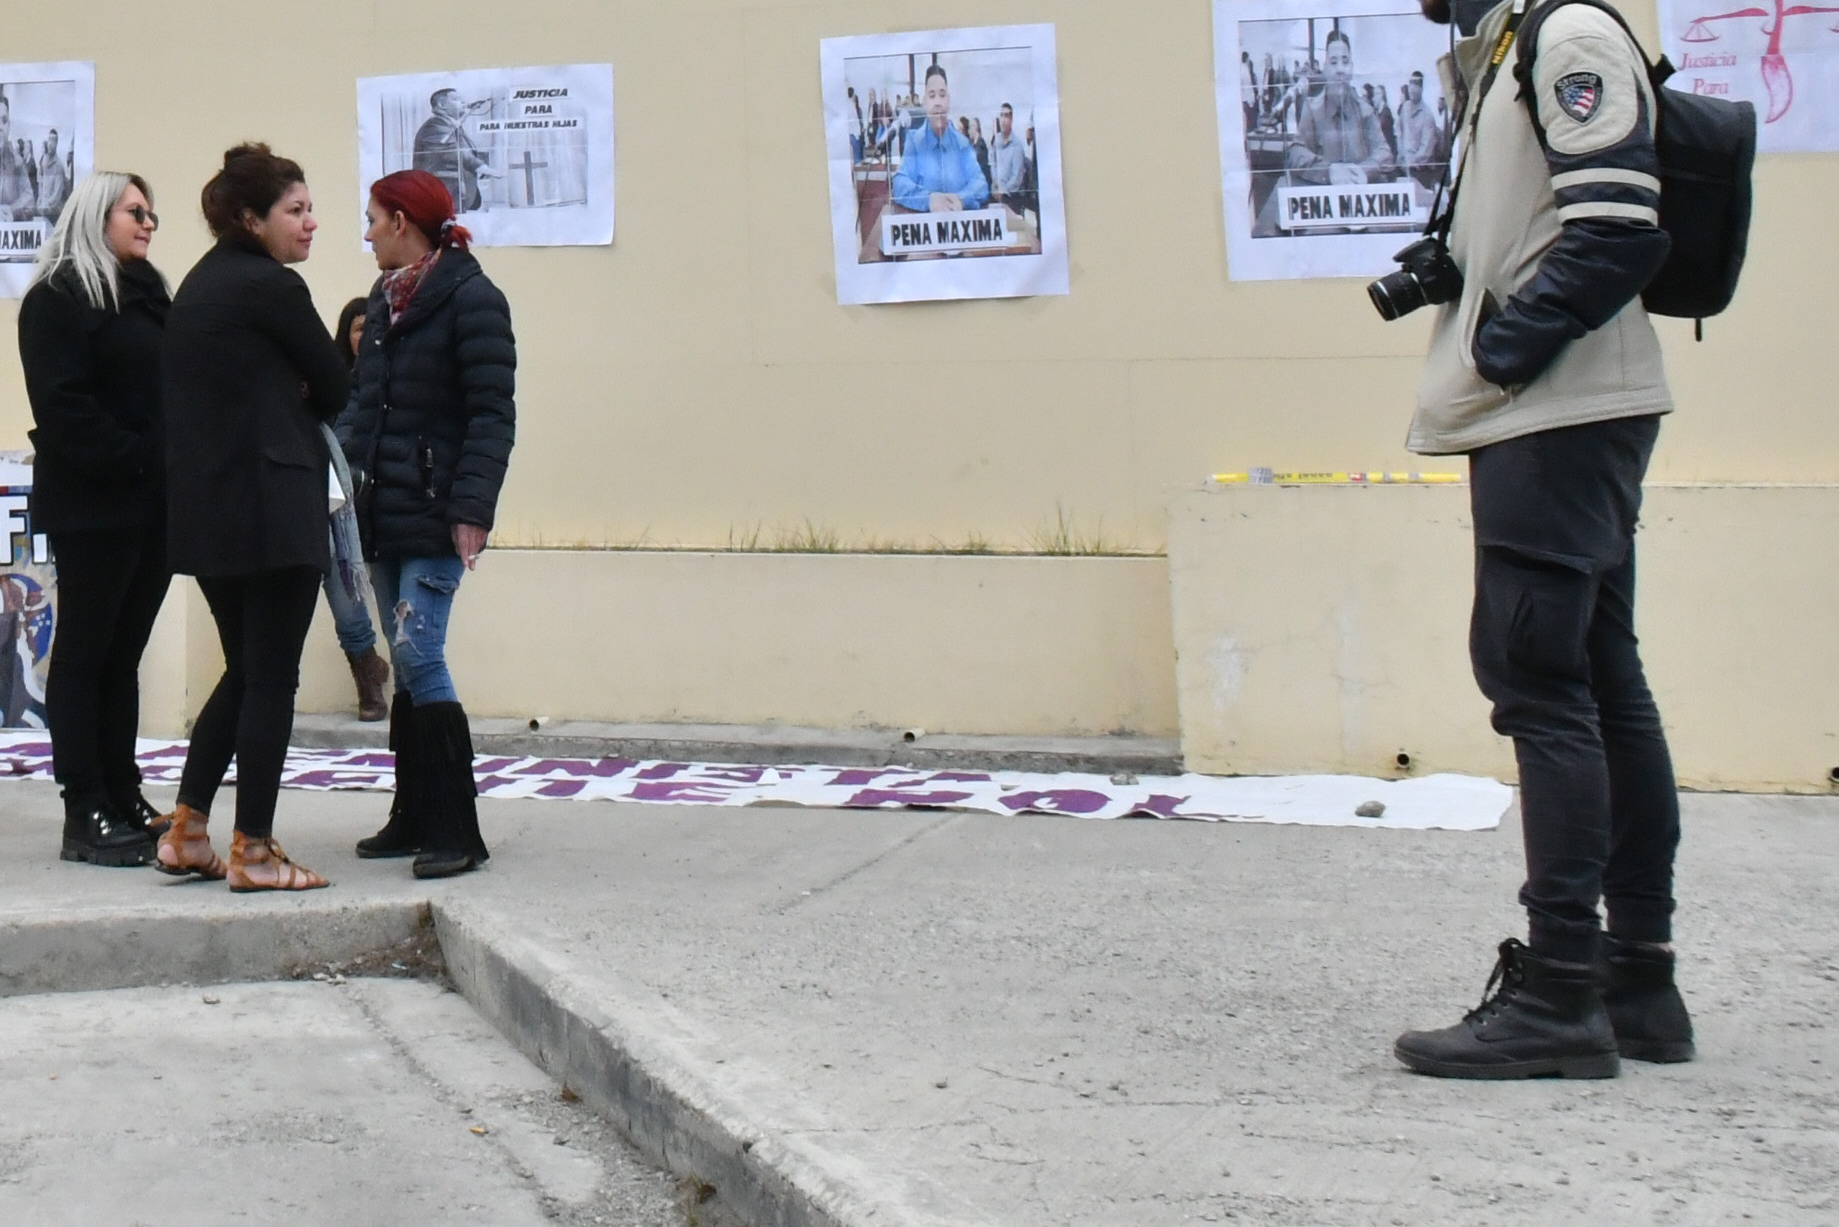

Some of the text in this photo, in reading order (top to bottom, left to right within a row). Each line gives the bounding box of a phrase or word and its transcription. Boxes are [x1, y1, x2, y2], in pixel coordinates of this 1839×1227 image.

[1677, 52, 1736, 71] Justicia
[1557, 74, 1597, 90] Strong
[1693, 78, 1728, 95] Para
[513, 88, 568, 99] JUSTICIA
[524, 104, 553, 115] PARA
[479, 119, 578, 131] PARA NUESTRAS HIJAS
[1289, 193, 1411, 221] PENA MAXIMA
[891, 218, 1003, 246] PENA MAXIMA
